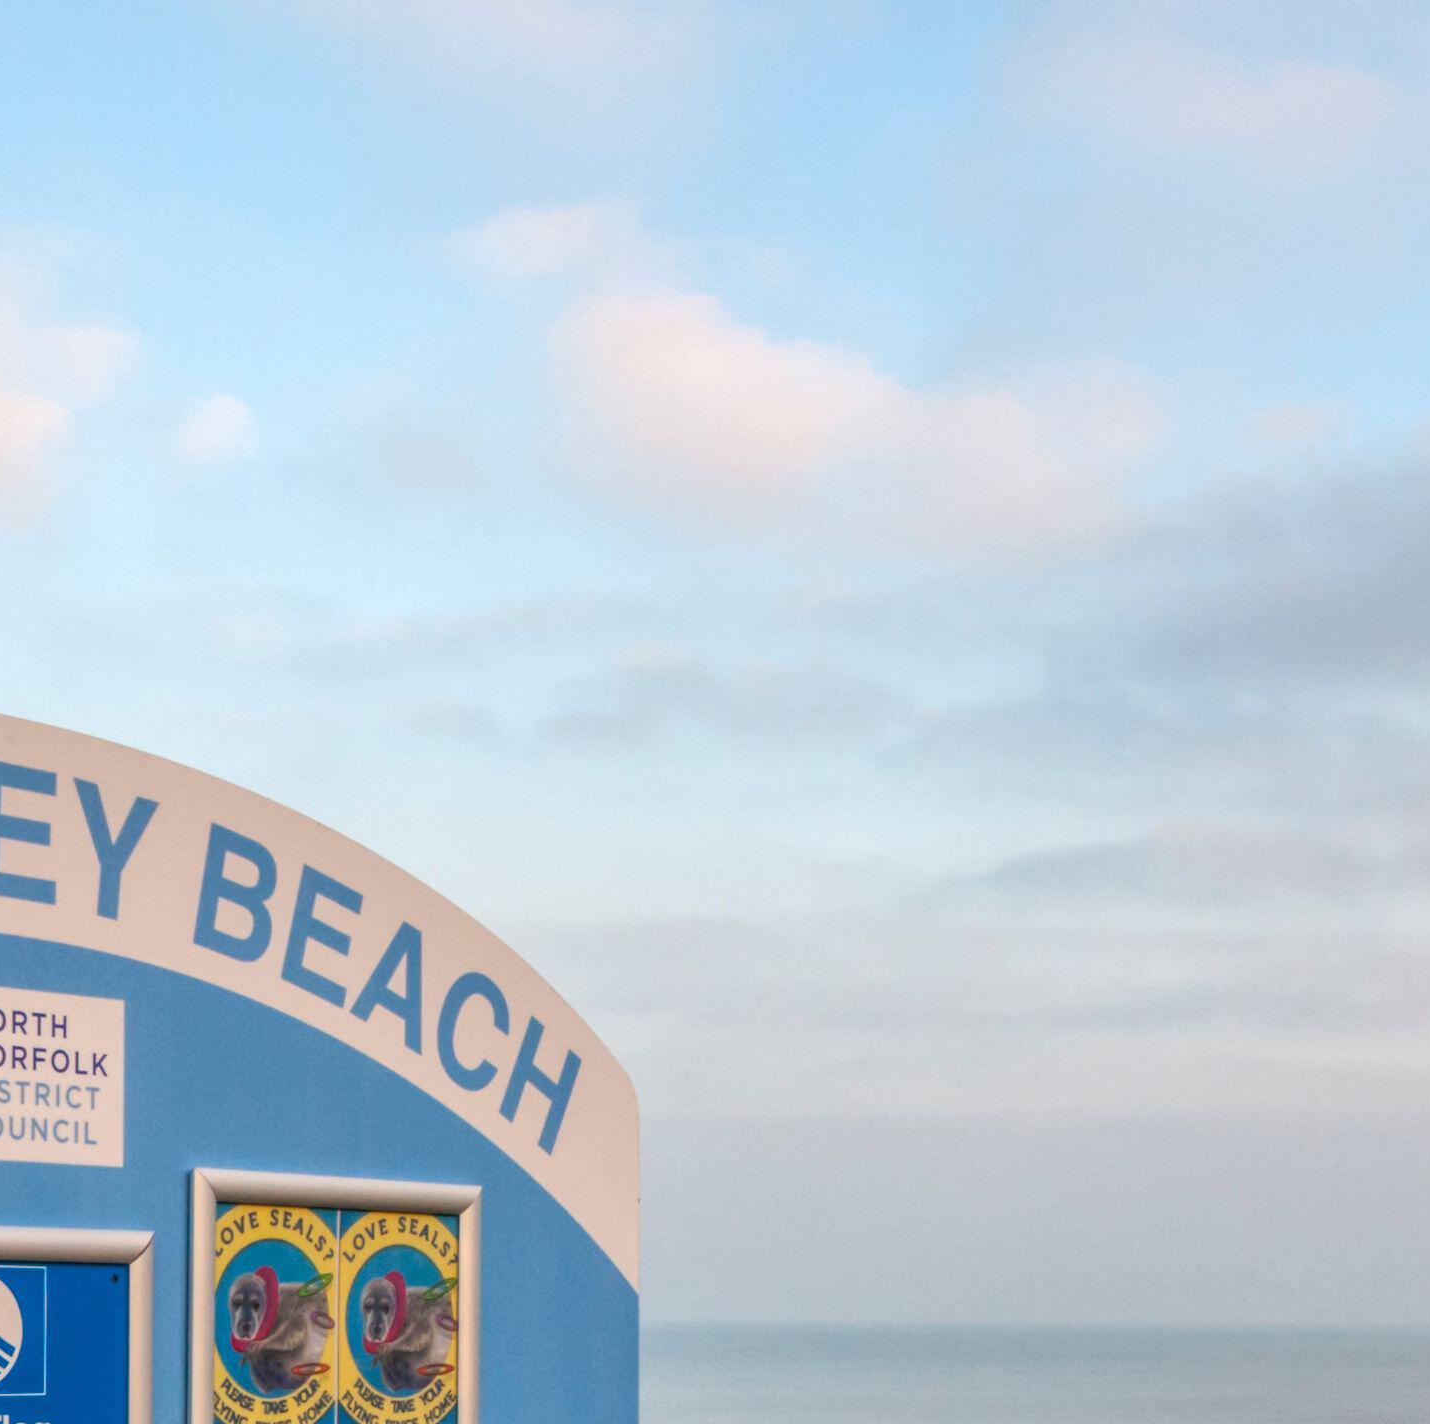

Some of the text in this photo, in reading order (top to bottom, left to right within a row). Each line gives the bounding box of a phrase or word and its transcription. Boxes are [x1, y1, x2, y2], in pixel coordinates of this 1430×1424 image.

[193, 823, 582, 1155] BEACH
[270, 1209, 334, 1261] SEALS?
[343, 1218, 388, 1263] LOVE
[221, 1377, 320, 1415] PLEASE TAKE YOUR
[354, 1377, 445, 1413] PLEASE TAKE YOUR
[424, 1390, 457, 1424] HOME
